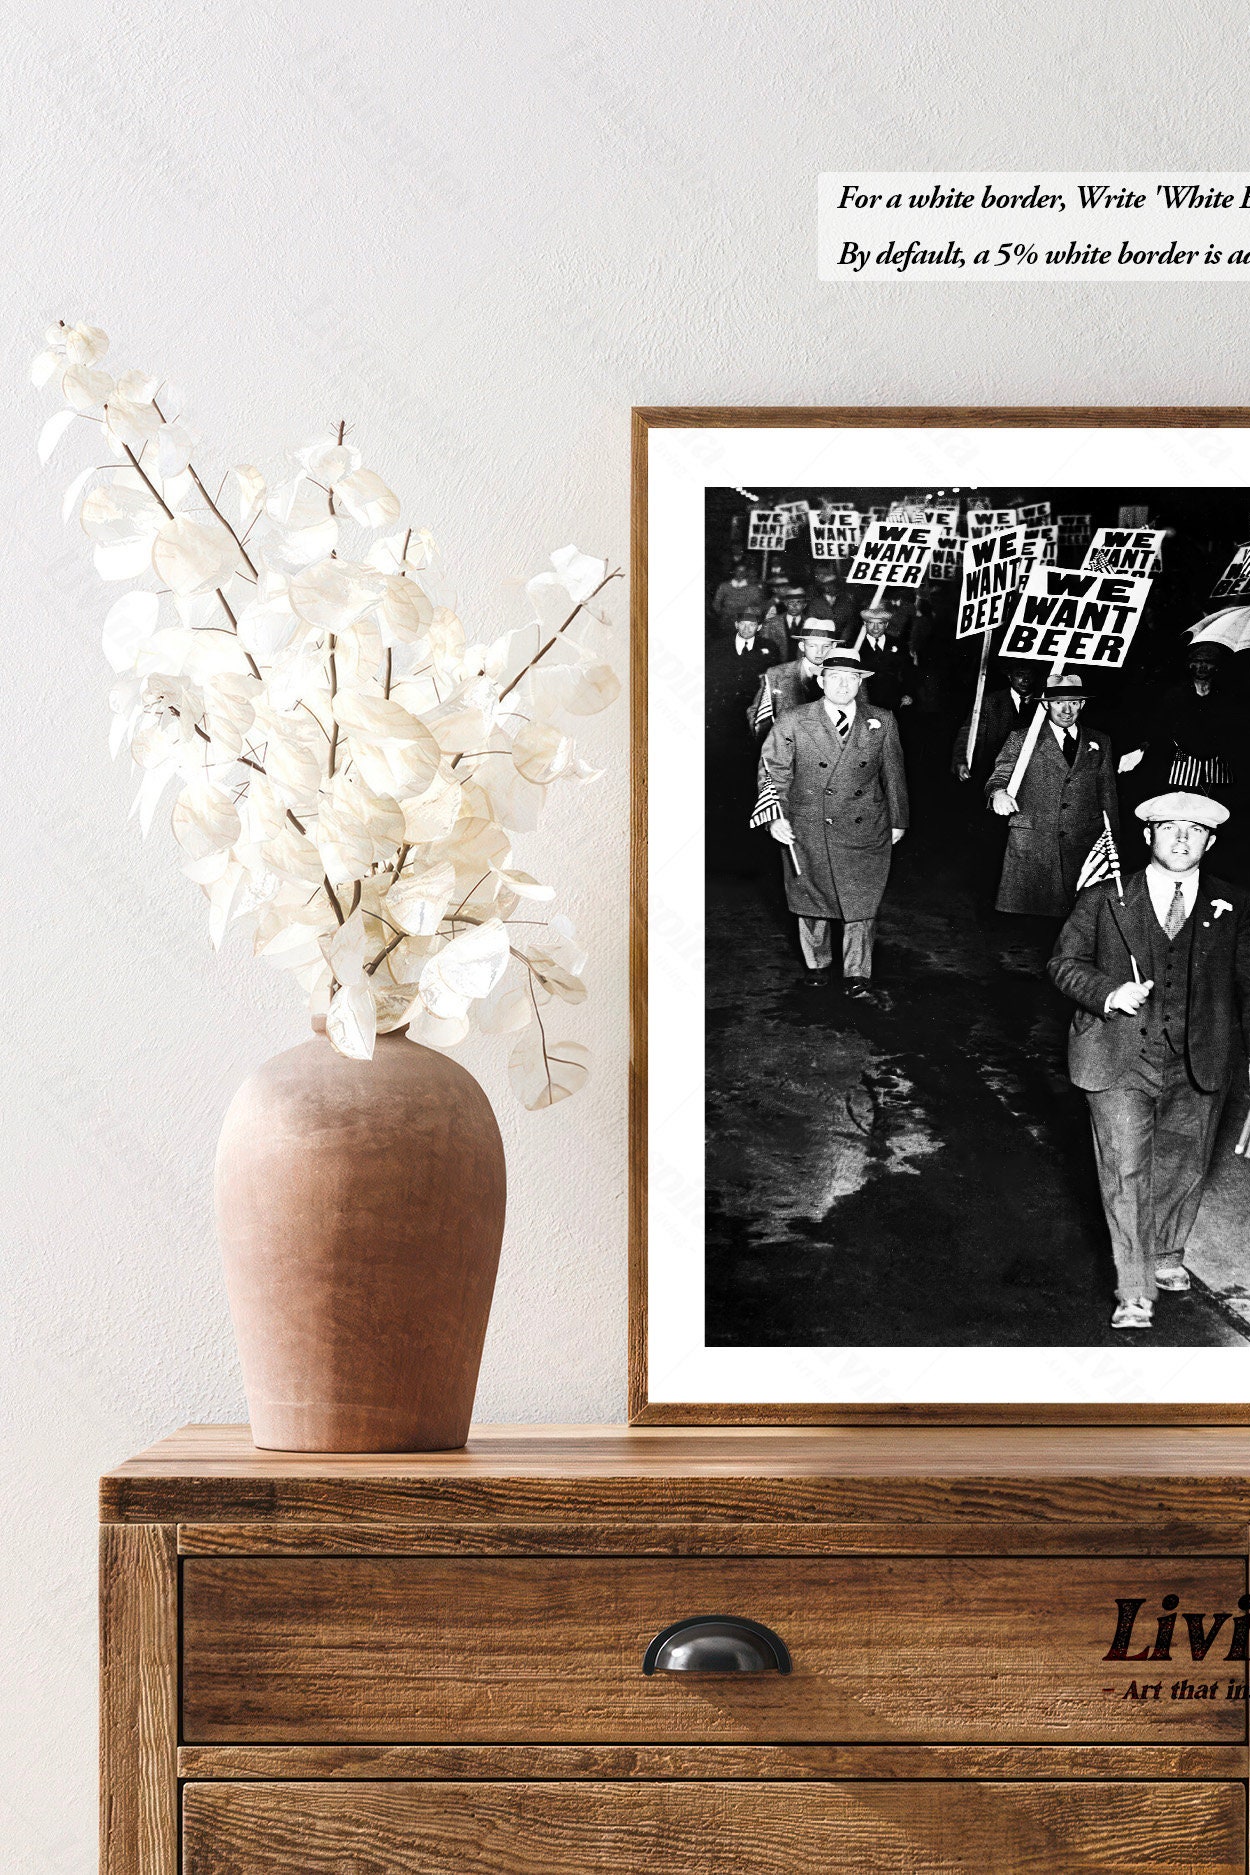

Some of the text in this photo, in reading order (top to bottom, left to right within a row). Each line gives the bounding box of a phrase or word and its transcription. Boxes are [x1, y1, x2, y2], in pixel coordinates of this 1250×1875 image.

[974, 512, 1011, 526] WE
[813, 526, 857, 542] WANT
[878, 525, 932, 545] WE
[1103, 531, 1157, 549] WE
[863, 541, 932, 564] WANT
[971, 531, 1017, 568] WE
[852, 561, 921, 584] BEER
[965, 556, 1022, 602] WANT
[1046, 570, 1135, 604] WE
[1022, 594, 1138, 634] WANT
[1006, 624, 1125, 662] BEER
